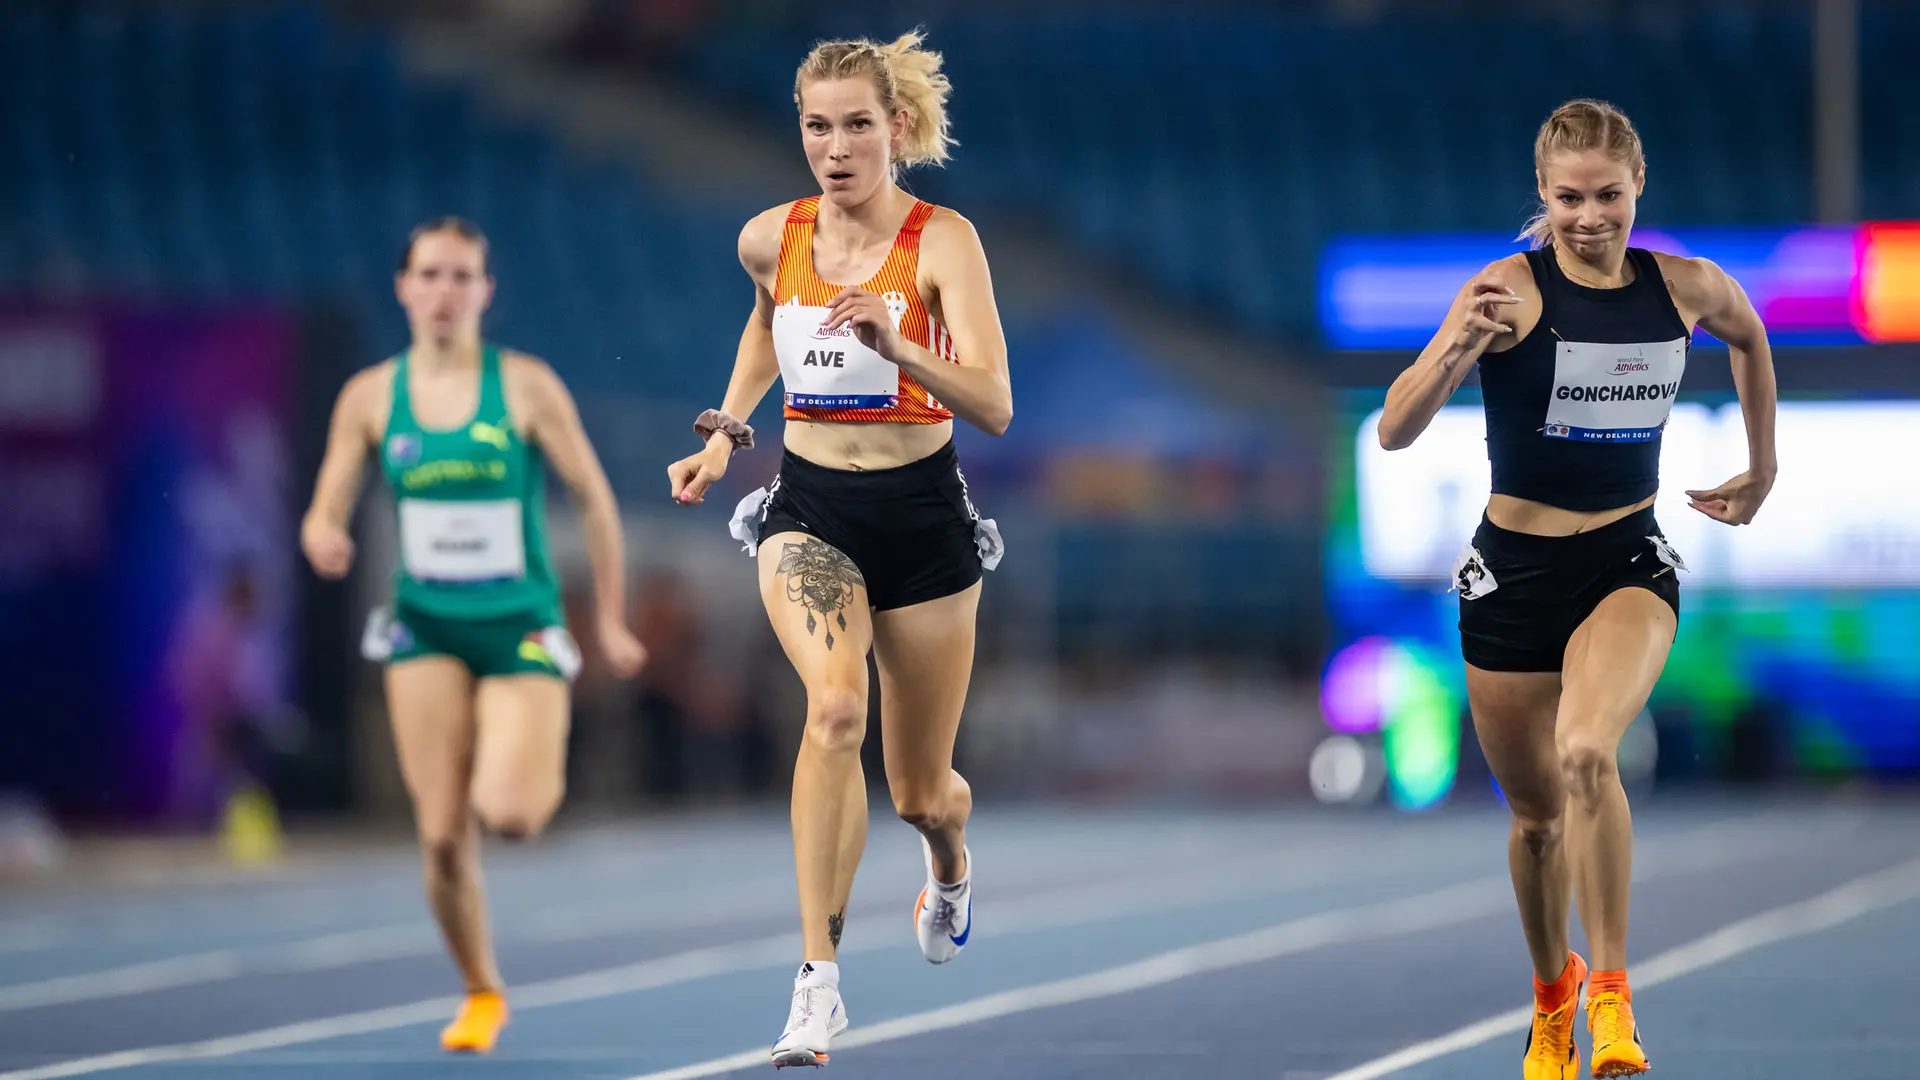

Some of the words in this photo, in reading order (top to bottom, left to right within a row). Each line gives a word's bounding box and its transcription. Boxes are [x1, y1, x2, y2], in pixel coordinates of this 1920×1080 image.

[803, 350, 844, 368] AVE
[1614, 362, 1650, 372] Athletics
[1556, 381, 1677, 403] GONCHAROVA
